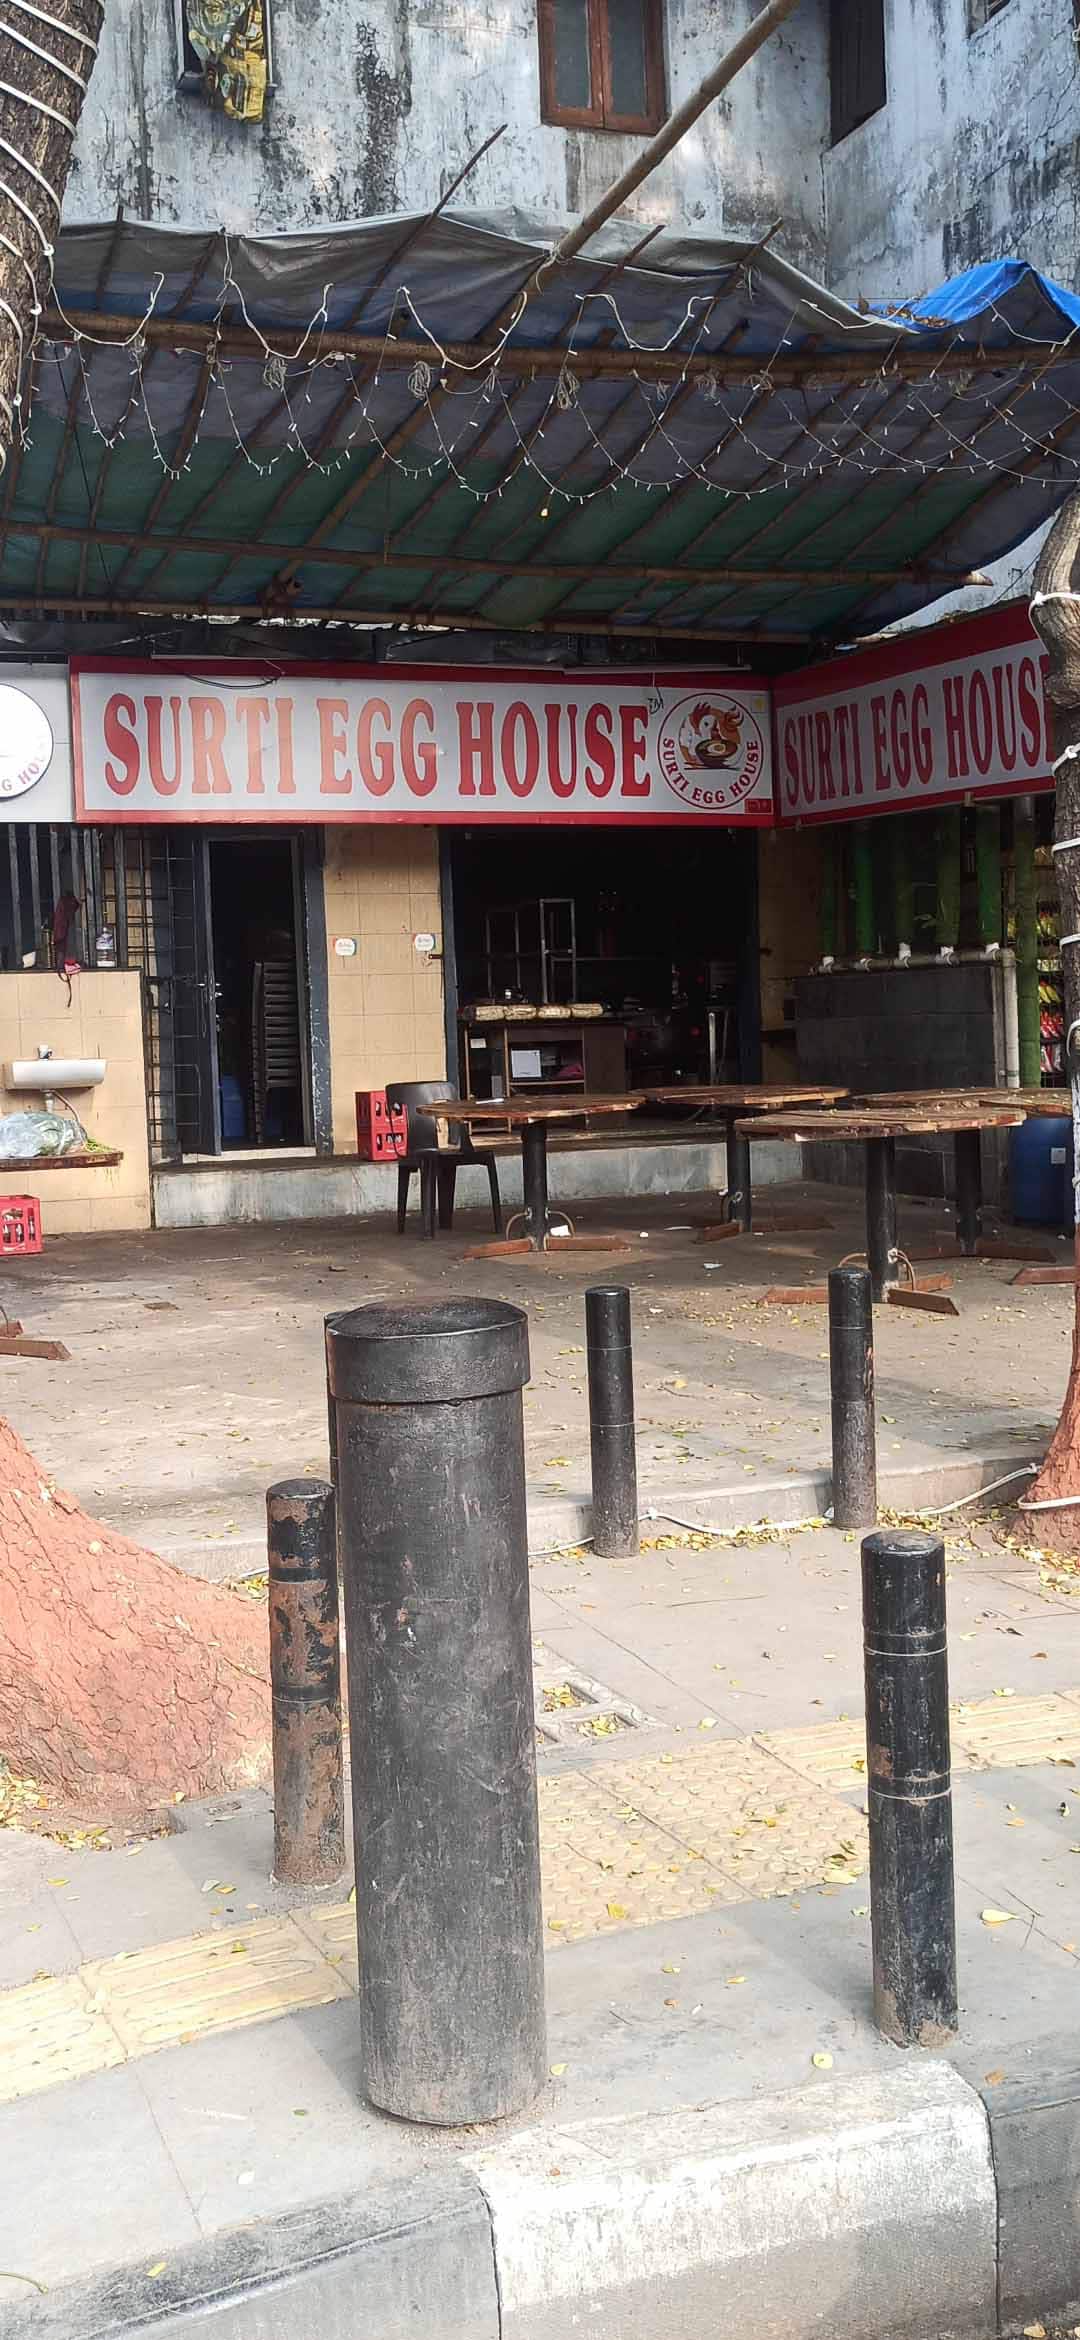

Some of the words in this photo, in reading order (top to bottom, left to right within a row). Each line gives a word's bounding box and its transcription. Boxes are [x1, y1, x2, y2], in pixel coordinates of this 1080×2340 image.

[103, 694, 295, 797] SURTI
[316, 698, 438, 799] EGG
[455, 702, 653, 799] HOUSE
[662, 737, 690, 793] SURTI
[691, 787, 726, 804] EGG
[729, 740, 760, 798] HOUSE
[783, 703, 865, 807] SURTI
[870, 683, 934, 791] EGG
